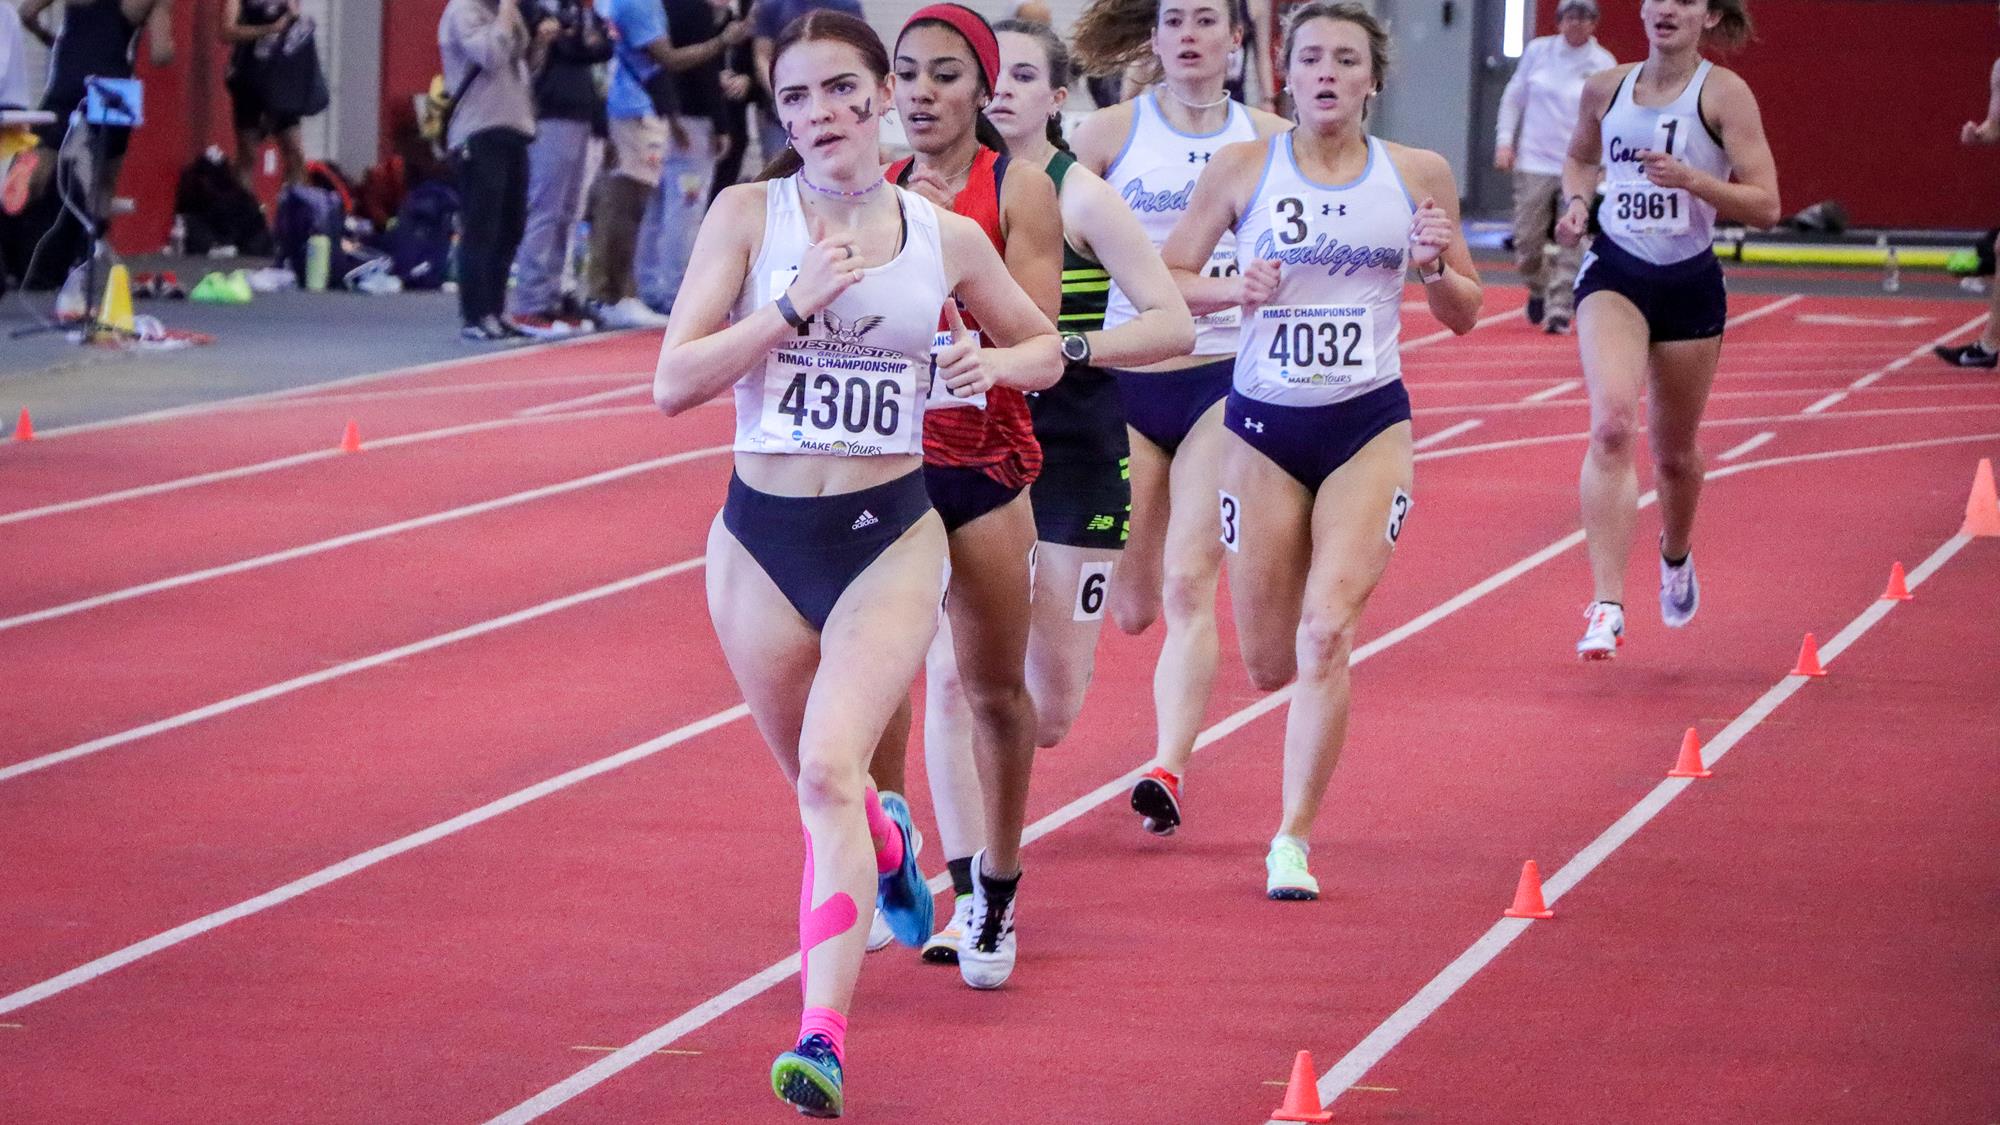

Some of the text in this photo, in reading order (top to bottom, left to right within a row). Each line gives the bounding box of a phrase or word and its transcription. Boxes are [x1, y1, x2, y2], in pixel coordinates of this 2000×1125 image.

[1661, 119, 1679, 155] 1
[1275, 197, 1308, 245] 3
[1617, 192, 1678, 220] 3961
[1262, 307, 1366, 319] RMAC CHAMPIONSHIP
[788, 339, 904, 360] WESTMINSTER
[1268, 322, 1363, 368] 4032
[777, 352, 908, 374] RMAC CHAMPIONSHIP
[1288, 372, 1352, 385] MAKE YOURS
[777, 372, 901, 436] 4306
[800, 440, 882, 456] MAKE YOURS
[851, 516, 879, 530] adidas
[1222, 497, 1236, 544] 3
[1390, 494, 1407, 542] 3
[1081, 572, 1106, 614] 6
